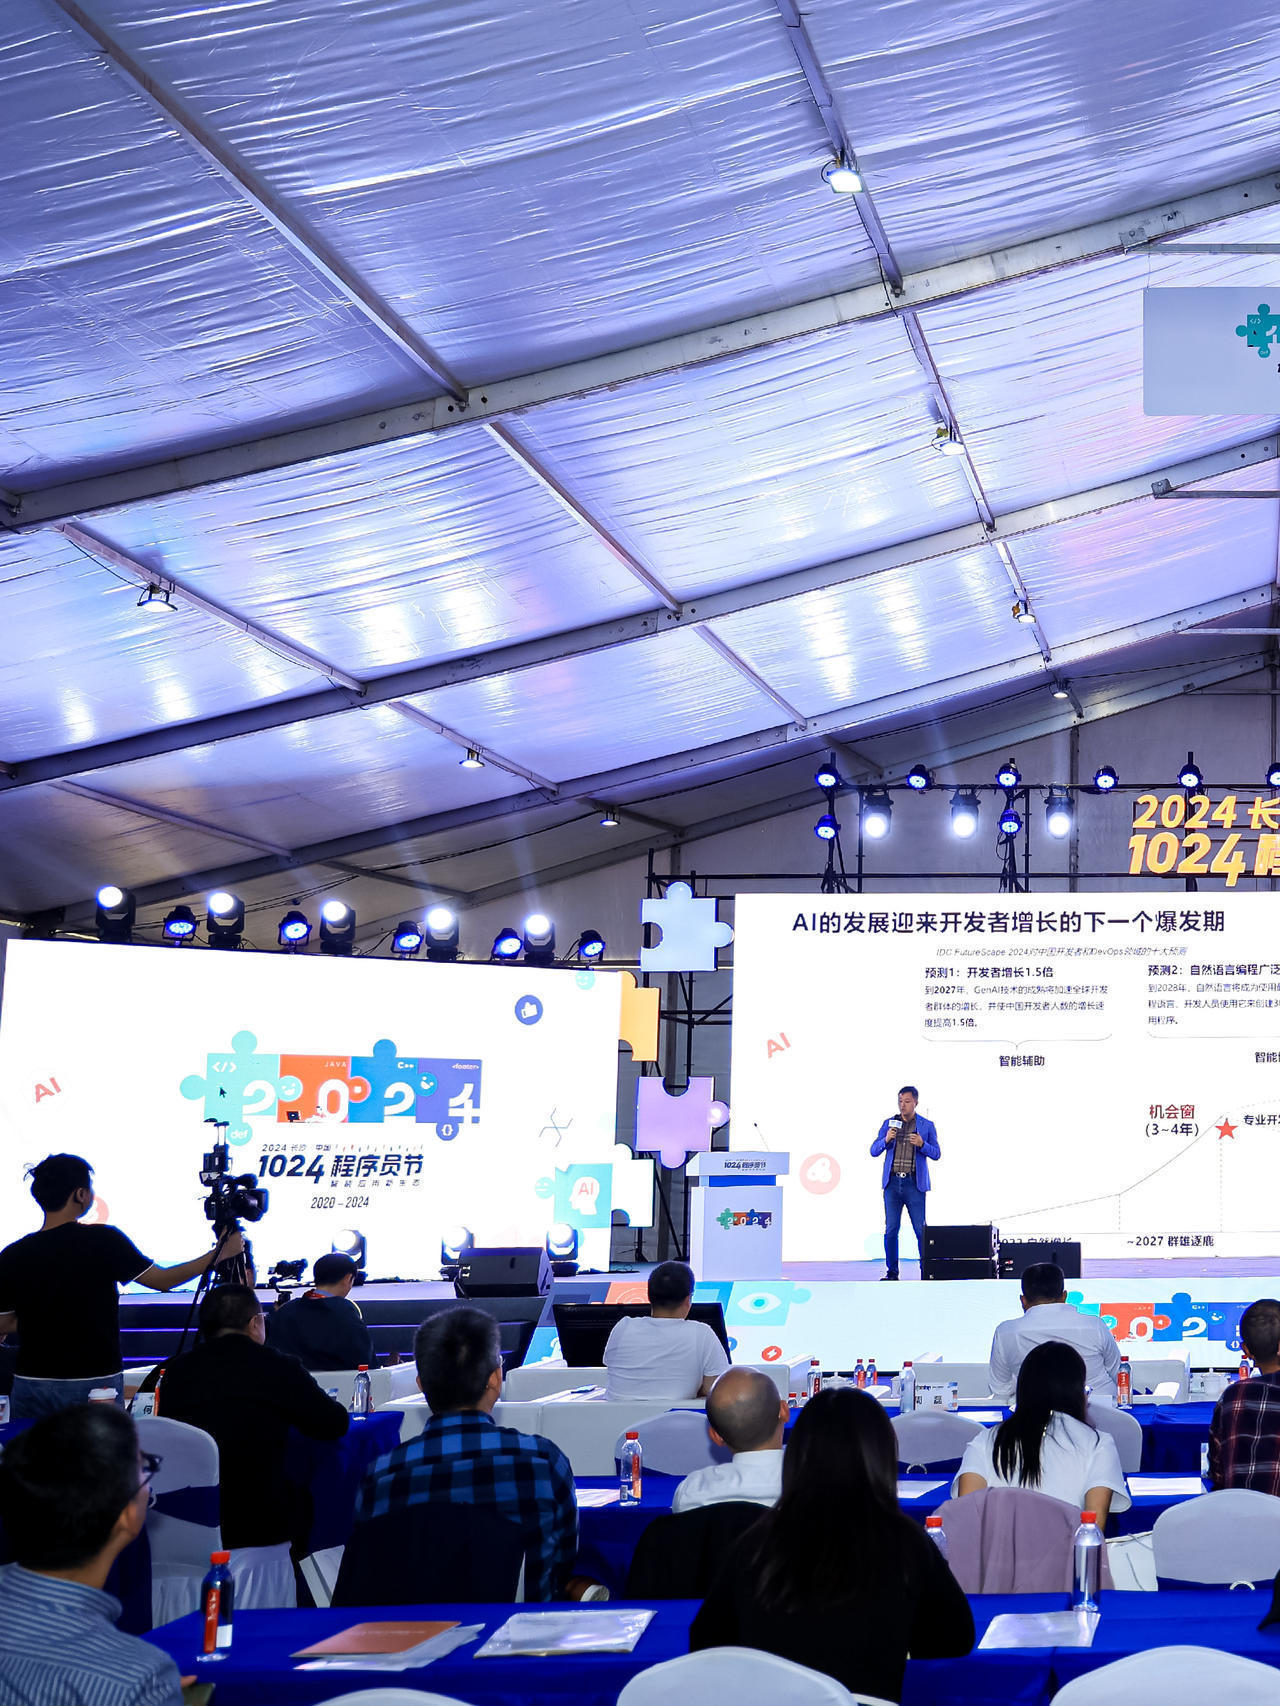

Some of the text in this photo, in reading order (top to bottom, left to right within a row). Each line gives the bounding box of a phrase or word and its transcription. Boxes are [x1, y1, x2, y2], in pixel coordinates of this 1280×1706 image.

[1132, 794, 1237, 829] 2024
[1129, 831, 1247, 887] 1024
[792, 910, 1224, 933] AI的发展迎来开发者增长的下一个爆发期
[925, 967, 1053, 978] 预测1：开发者增长1.5倍
[766, 1031, 791, 1059] AI
[999, 1056, 1045, 1067] 智能辅助
[35, 1076, 62, 1103] AI
[241, 1078, 482, 1124] 2024
[1150, 1104, 1194, 1119] 机会窗
[230, 1129, 250, 1139] def
[262, 1144, 286, 1152] 2024
[257, 1154, 424, 1185] 1024 程序员节
[724, 1162, 741, 1170] 1024
[579, 1182, 594, 1196] AI
[311, 1197, 335, 1208] 2020
[346, 1196, 369, 1208] 2024
[727, 1217, 772, 1226] 2024
[1168, 1235, 1214, 1246] 群雄逐鹿
